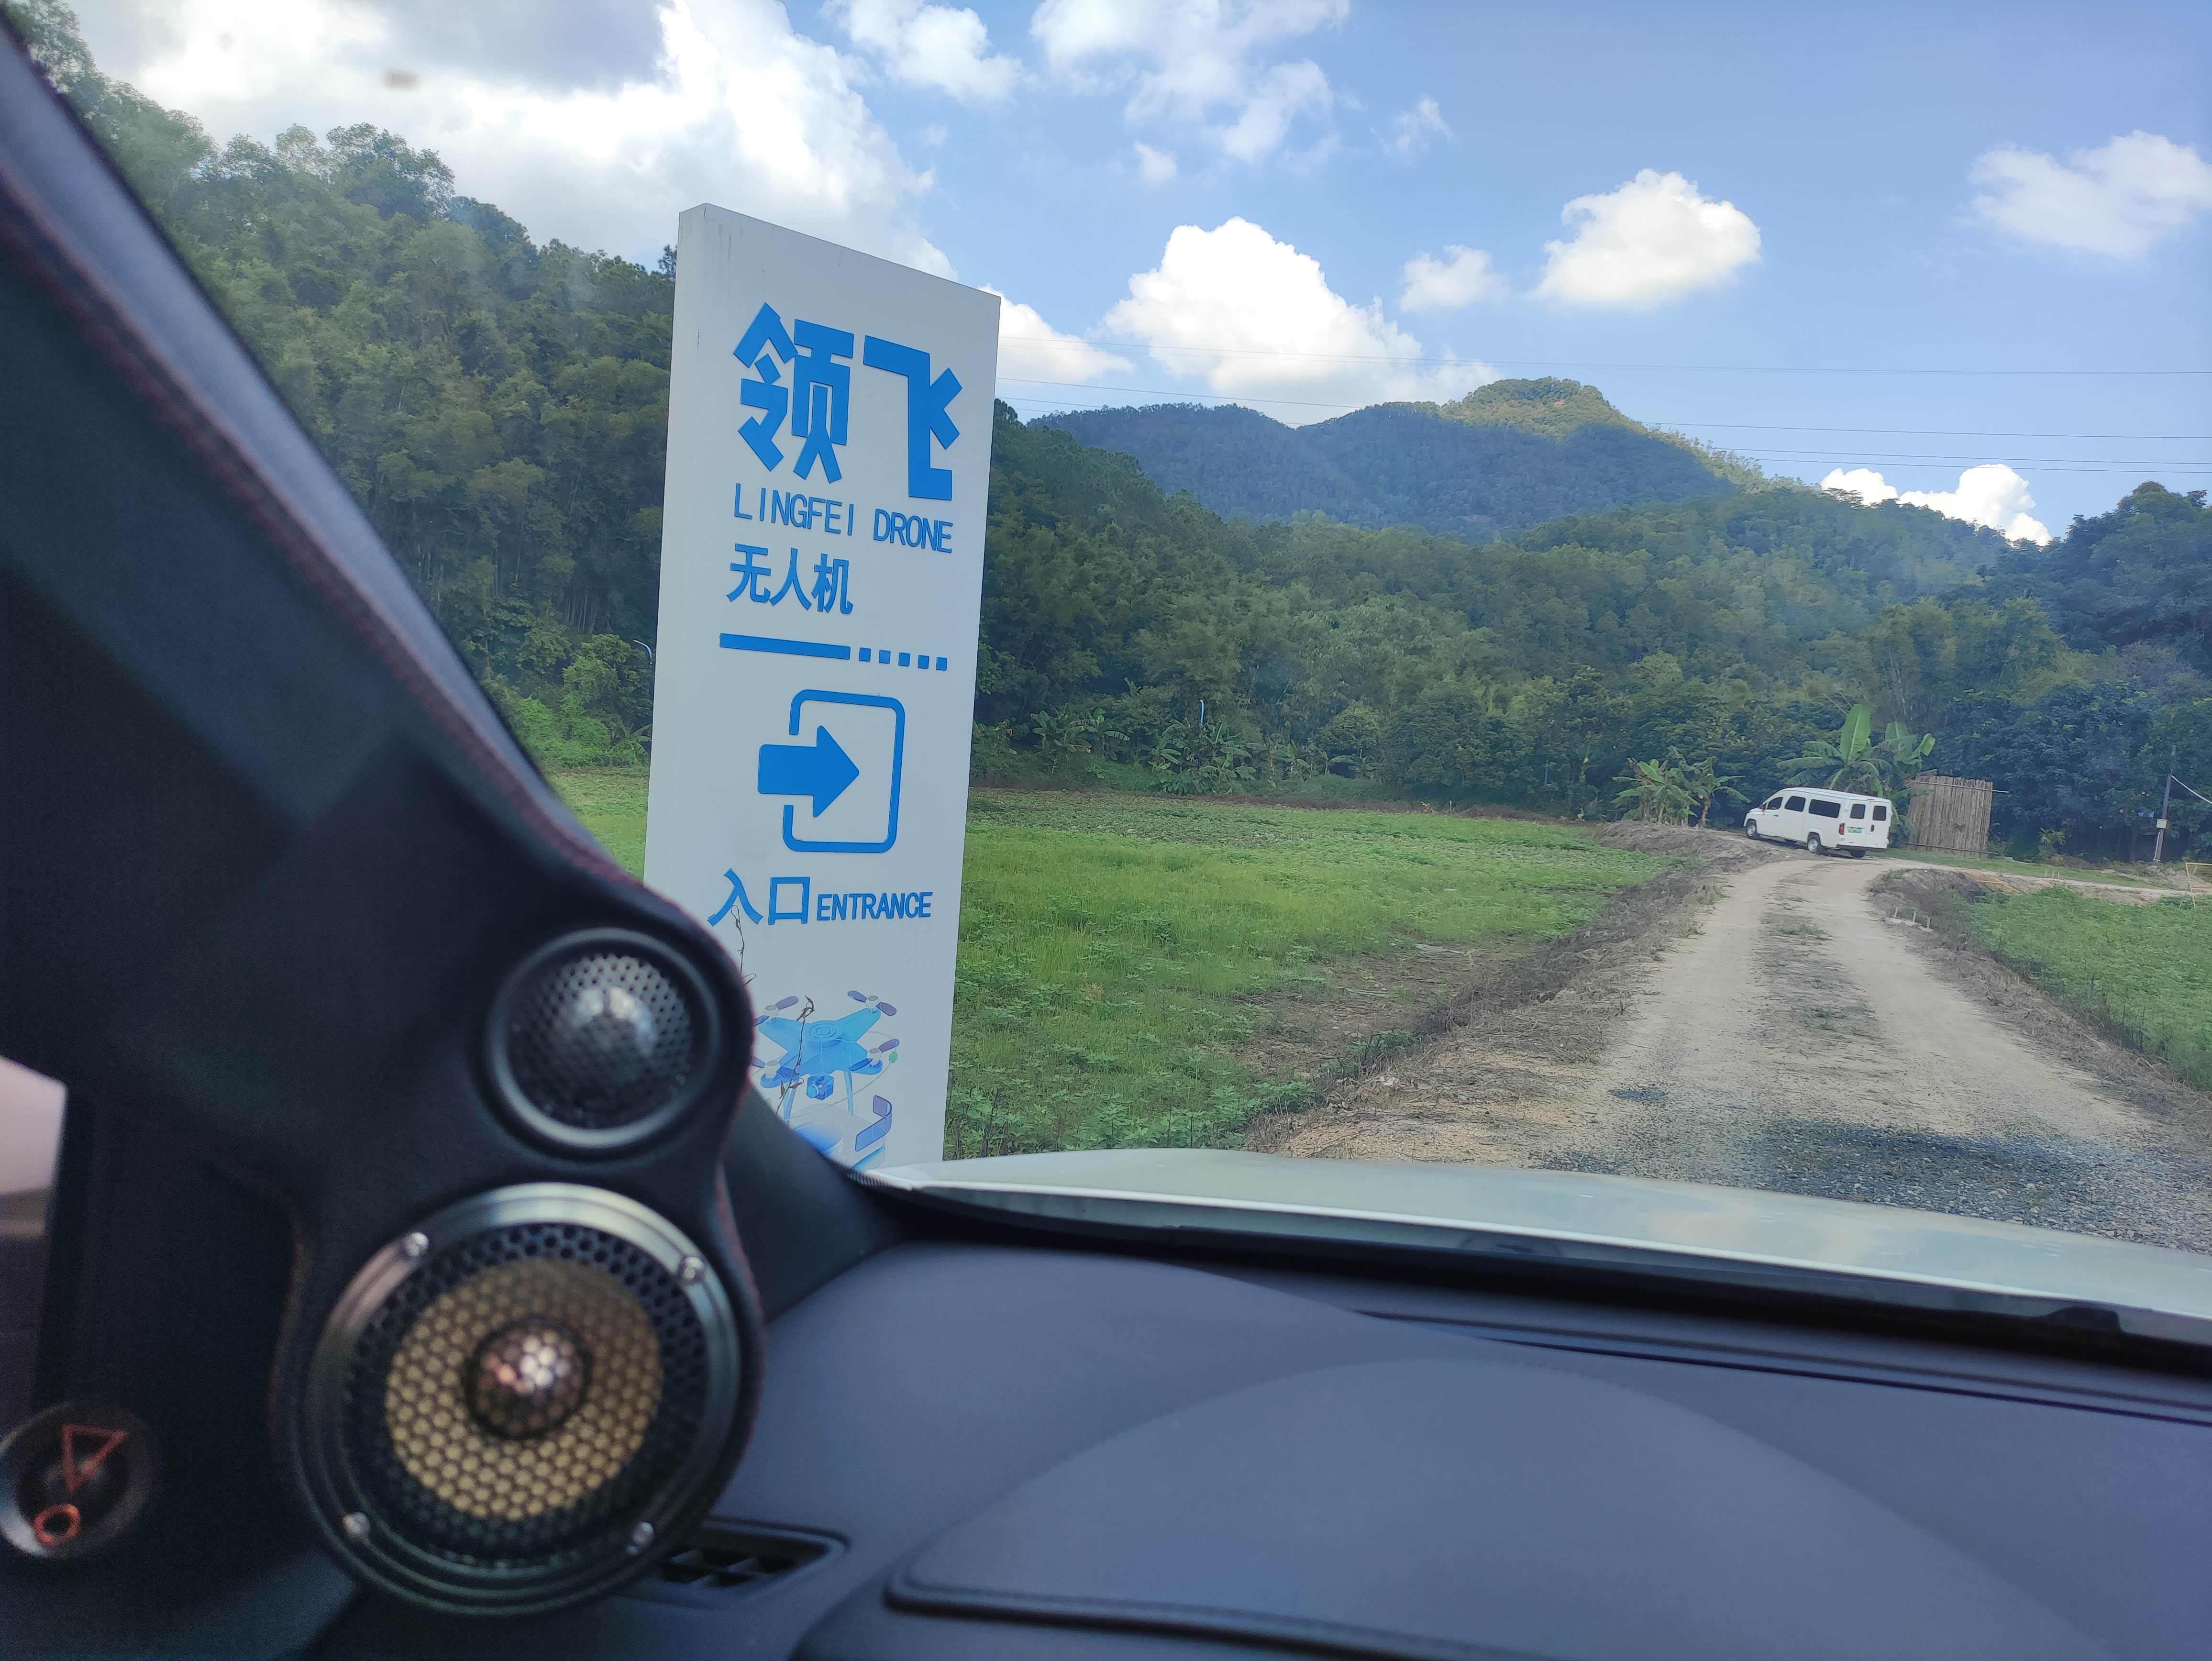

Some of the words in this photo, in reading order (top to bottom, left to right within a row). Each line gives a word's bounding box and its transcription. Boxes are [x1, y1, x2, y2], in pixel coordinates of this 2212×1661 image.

[733, 302, 962, 501] 领飞
[734, 483, 854, 536] LINGFEI
[873, 509, 953, 553] DRONE
[727, 543, 853, 615] 无人机
[708, 868, 811, 927] 入口
[817, 891, 933, 921] ENTRANCE
